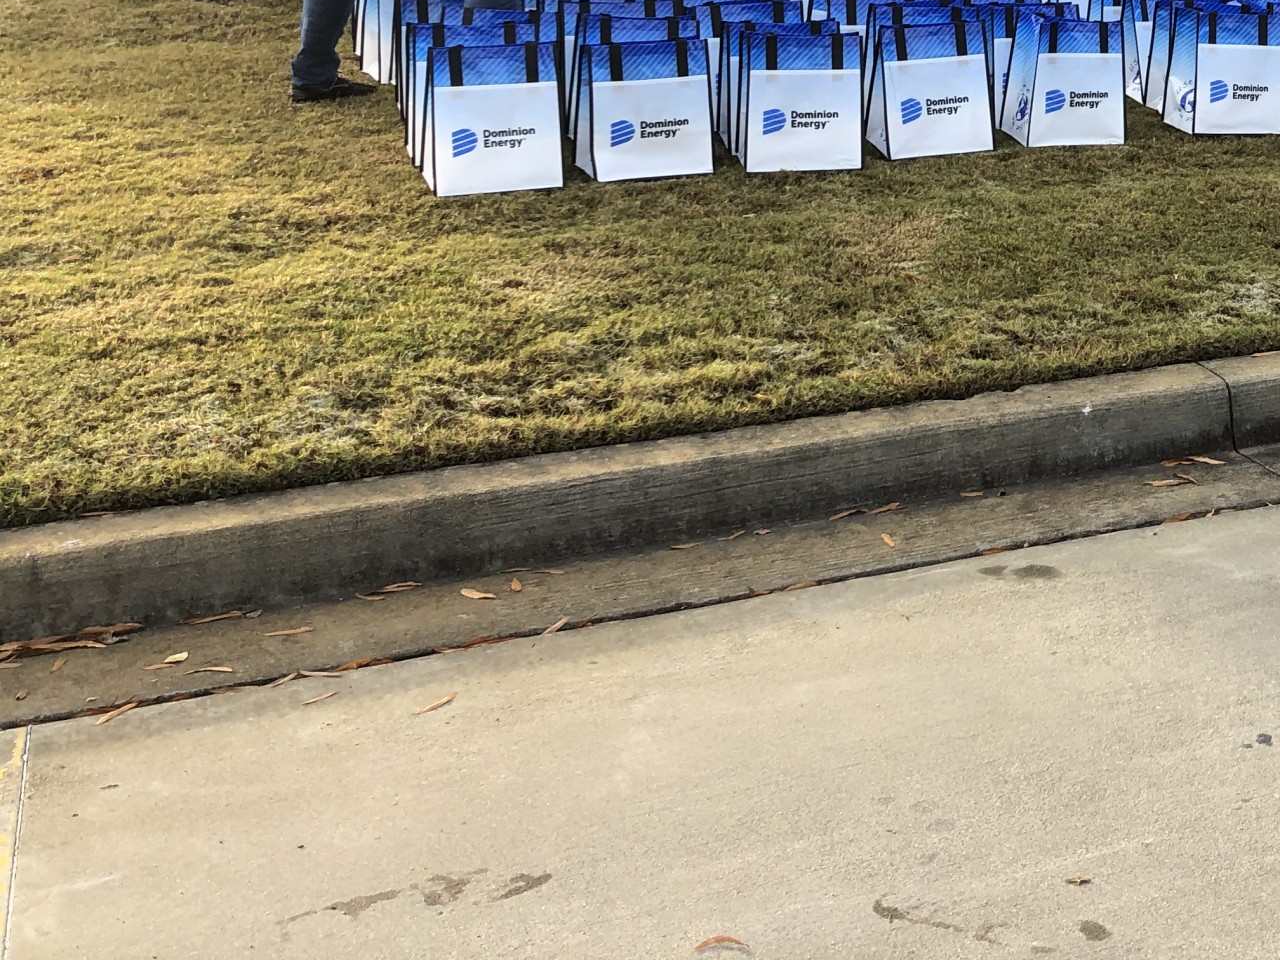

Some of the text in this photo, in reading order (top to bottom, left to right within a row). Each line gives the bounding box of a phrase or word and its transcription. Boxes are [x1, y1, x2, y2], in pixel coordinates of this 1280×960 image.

[1232, 84, 1269, 94] Dominion
[925, 95, 969, 107] Dominion
[1069, 90, 1109, 101] Dominion
[790, 109, 839, 120] Dominion
[640, 117, 689, 130] Dominion
[483, 126, 536, 138] Dominion
